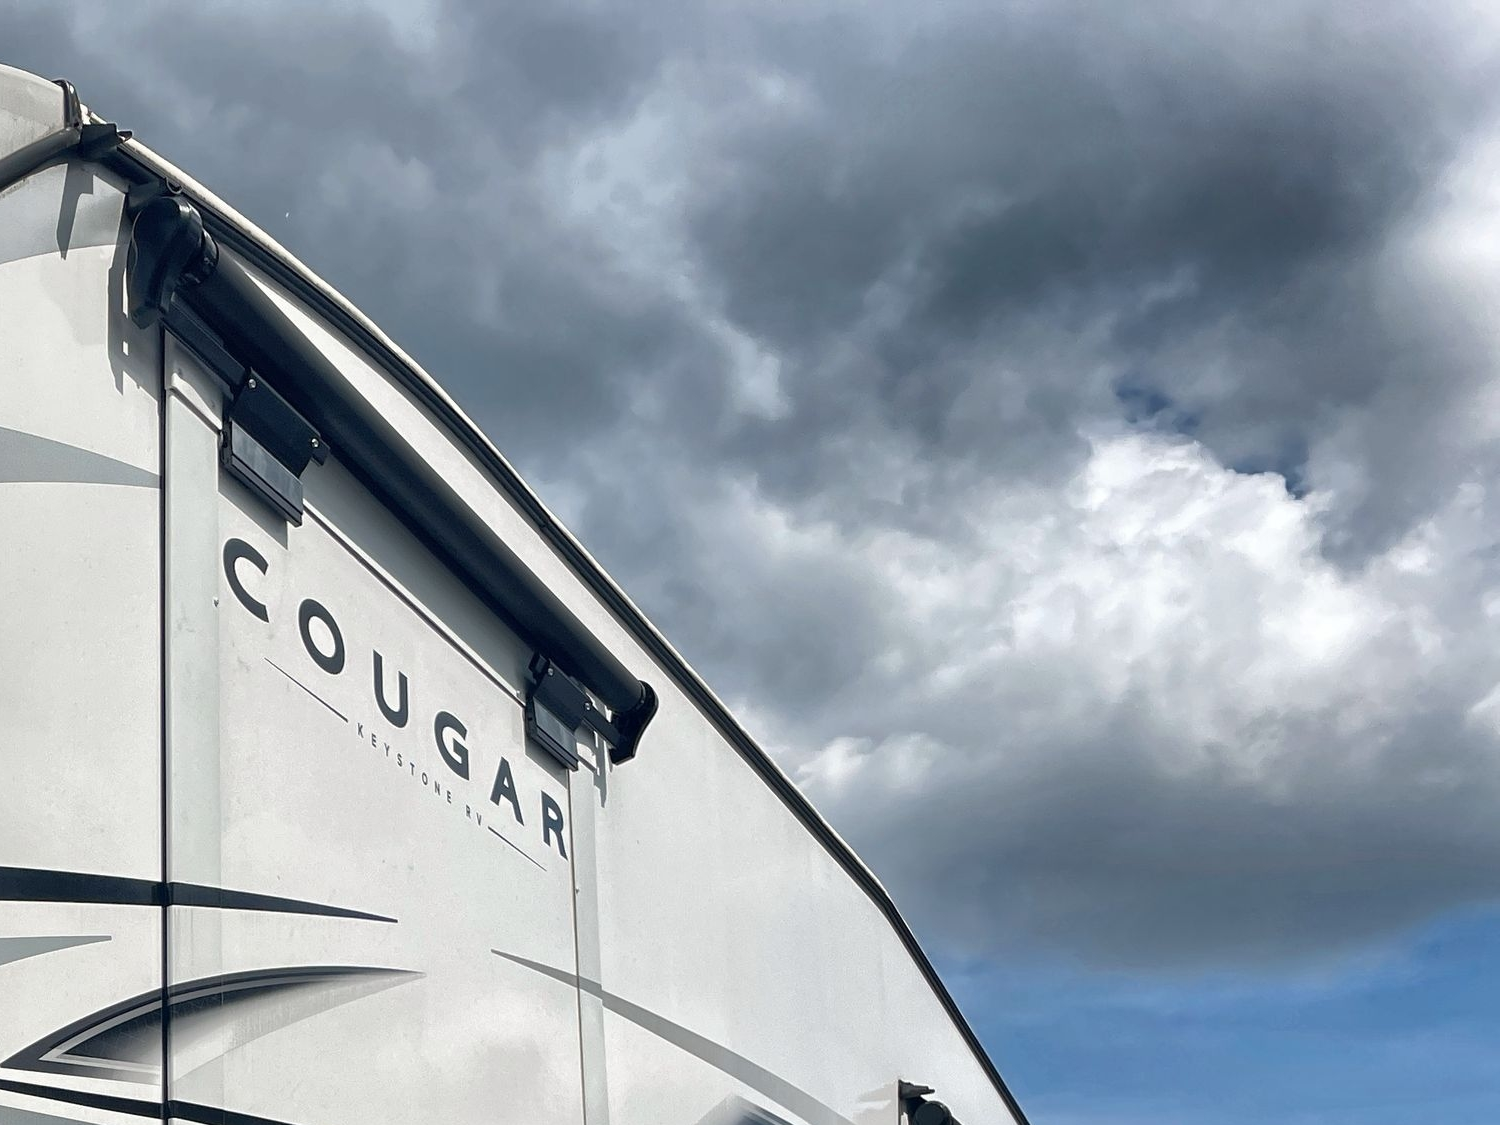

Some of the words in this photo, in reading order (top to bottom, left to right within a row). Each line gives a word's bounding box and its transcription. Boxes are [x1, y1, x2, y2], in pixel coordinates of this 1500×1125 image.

[222, 536, 569, 862] COUGAR
[357, 722, 452, 805] KEYSTONE
[465, 804, 483, 826] RV
